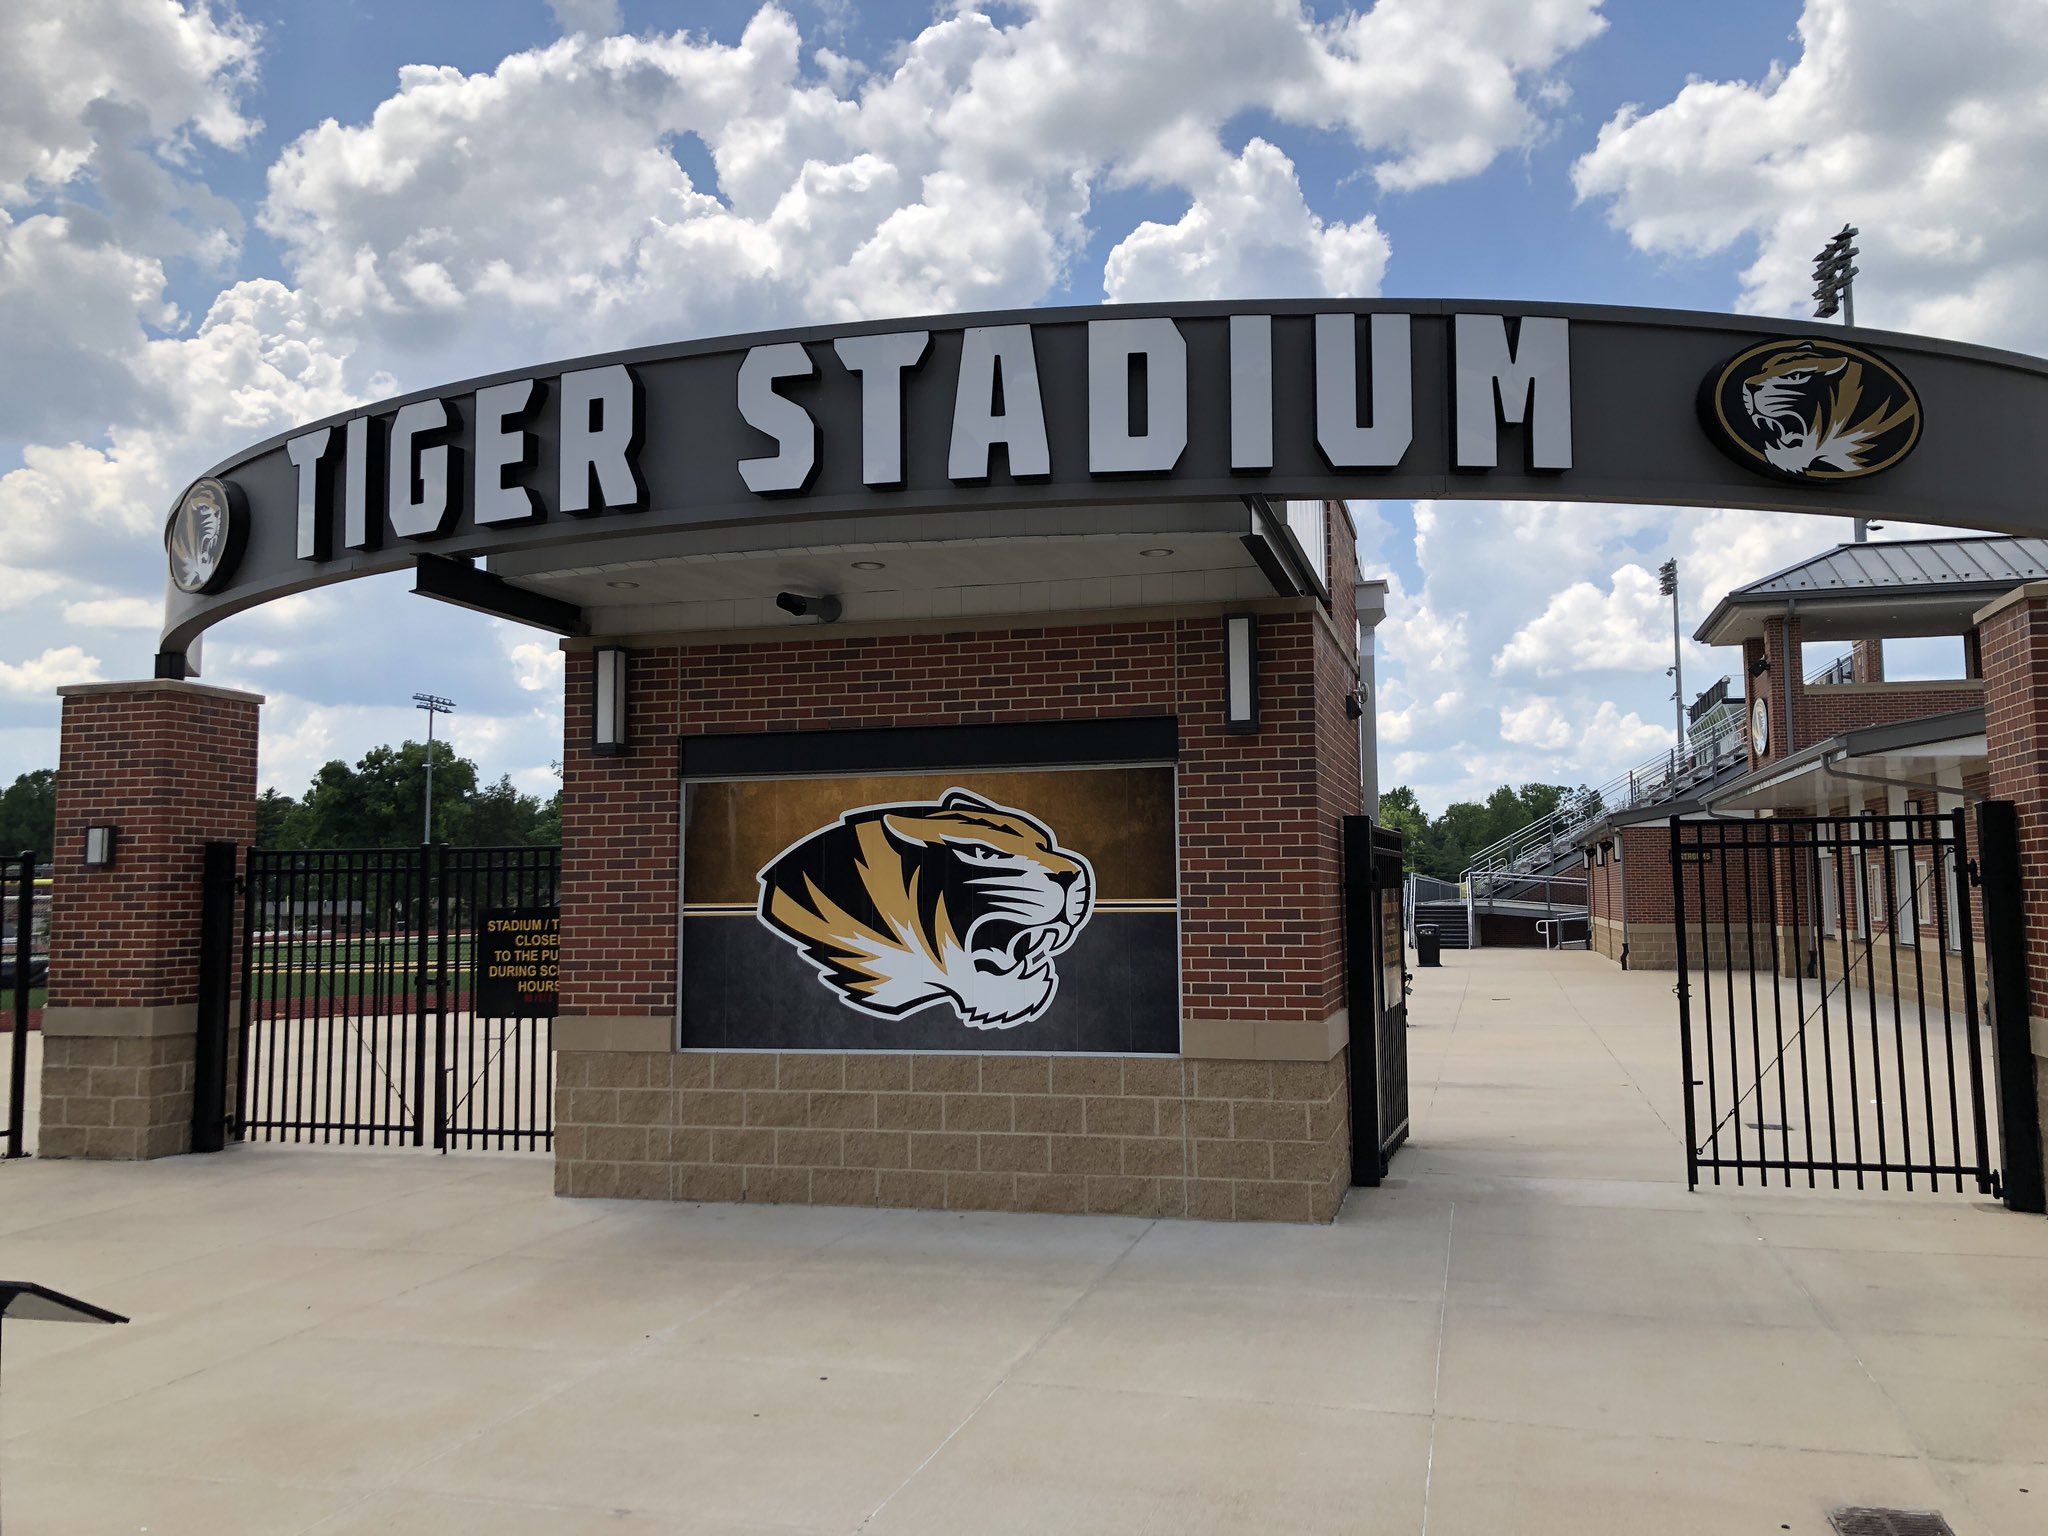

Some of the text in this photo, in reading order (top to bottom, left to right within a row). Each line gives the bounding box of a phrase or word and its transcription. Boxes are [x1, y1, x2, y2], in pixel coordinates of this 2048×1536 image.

[286, 313, 1573, 562] TIGER STADIUM
[488, 920, 541, 931] STADIUM
[515, 935, 560, 946] CLOSE
[494, 950, 511, 962] TO
[514, 950, 538, 961] THE
[488, 964, 560, 977] DURING SC
